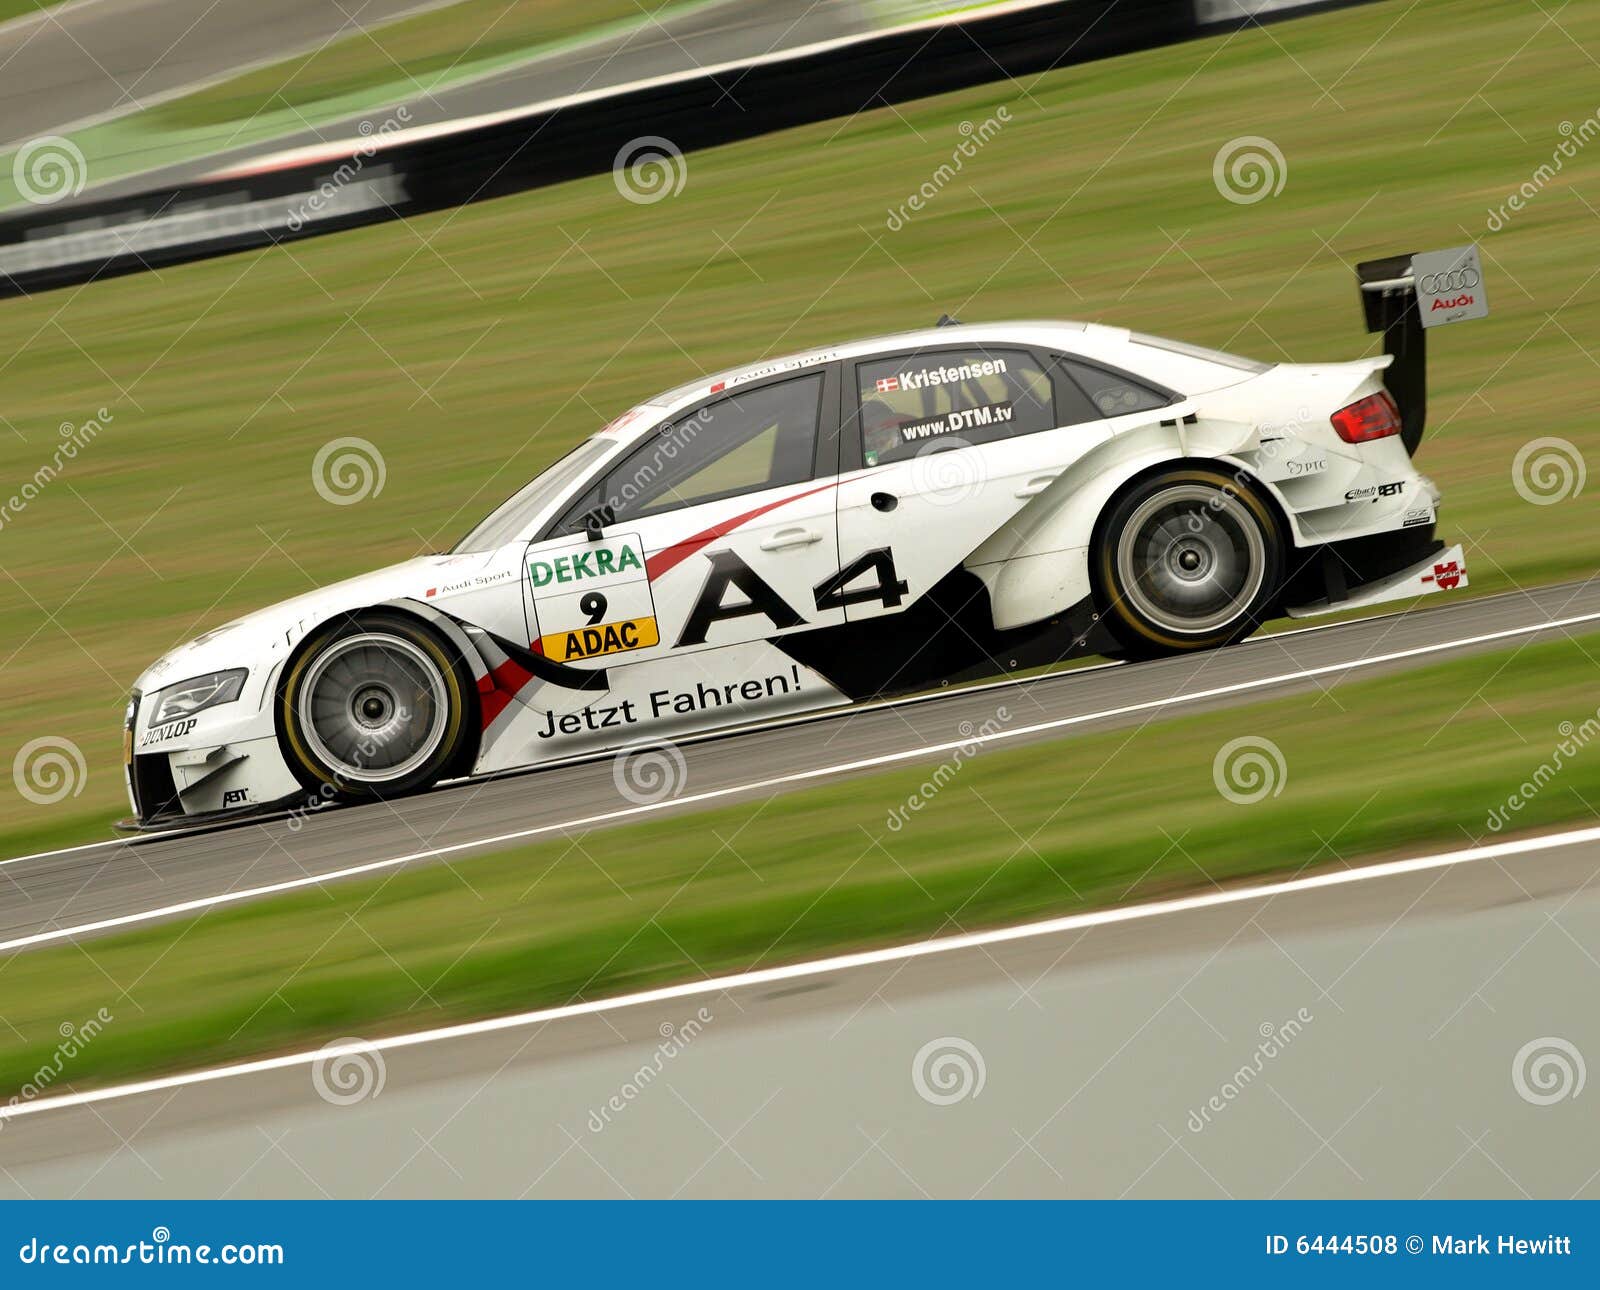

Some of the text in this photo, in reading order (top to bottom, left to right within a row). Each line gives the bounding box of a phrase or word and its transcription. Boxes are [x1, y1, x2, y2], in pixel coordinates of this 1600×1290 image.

[1431, 294, 1474, 312] Audi
[899, 358, 1007, 392] Kristensen
[903, 405, 1012, 440] www.DTM.tv
[1305, 460, 1326, 472] PTC
[1378, 481, 1405, 496] ABT
[442, 570, 512, 593] Audi Sport
[529, 544, 643, 588] DEKRA
[580, 591, 608, 626] 9
[670, 546, 909, 649] A4
[565, 622, 640, 660] ADAC
[537, 664, 801, 739] Jetzt Fahren!
[142, 719, 198, 747] DUNLOP
[223, 788, 249, 808] ABT
